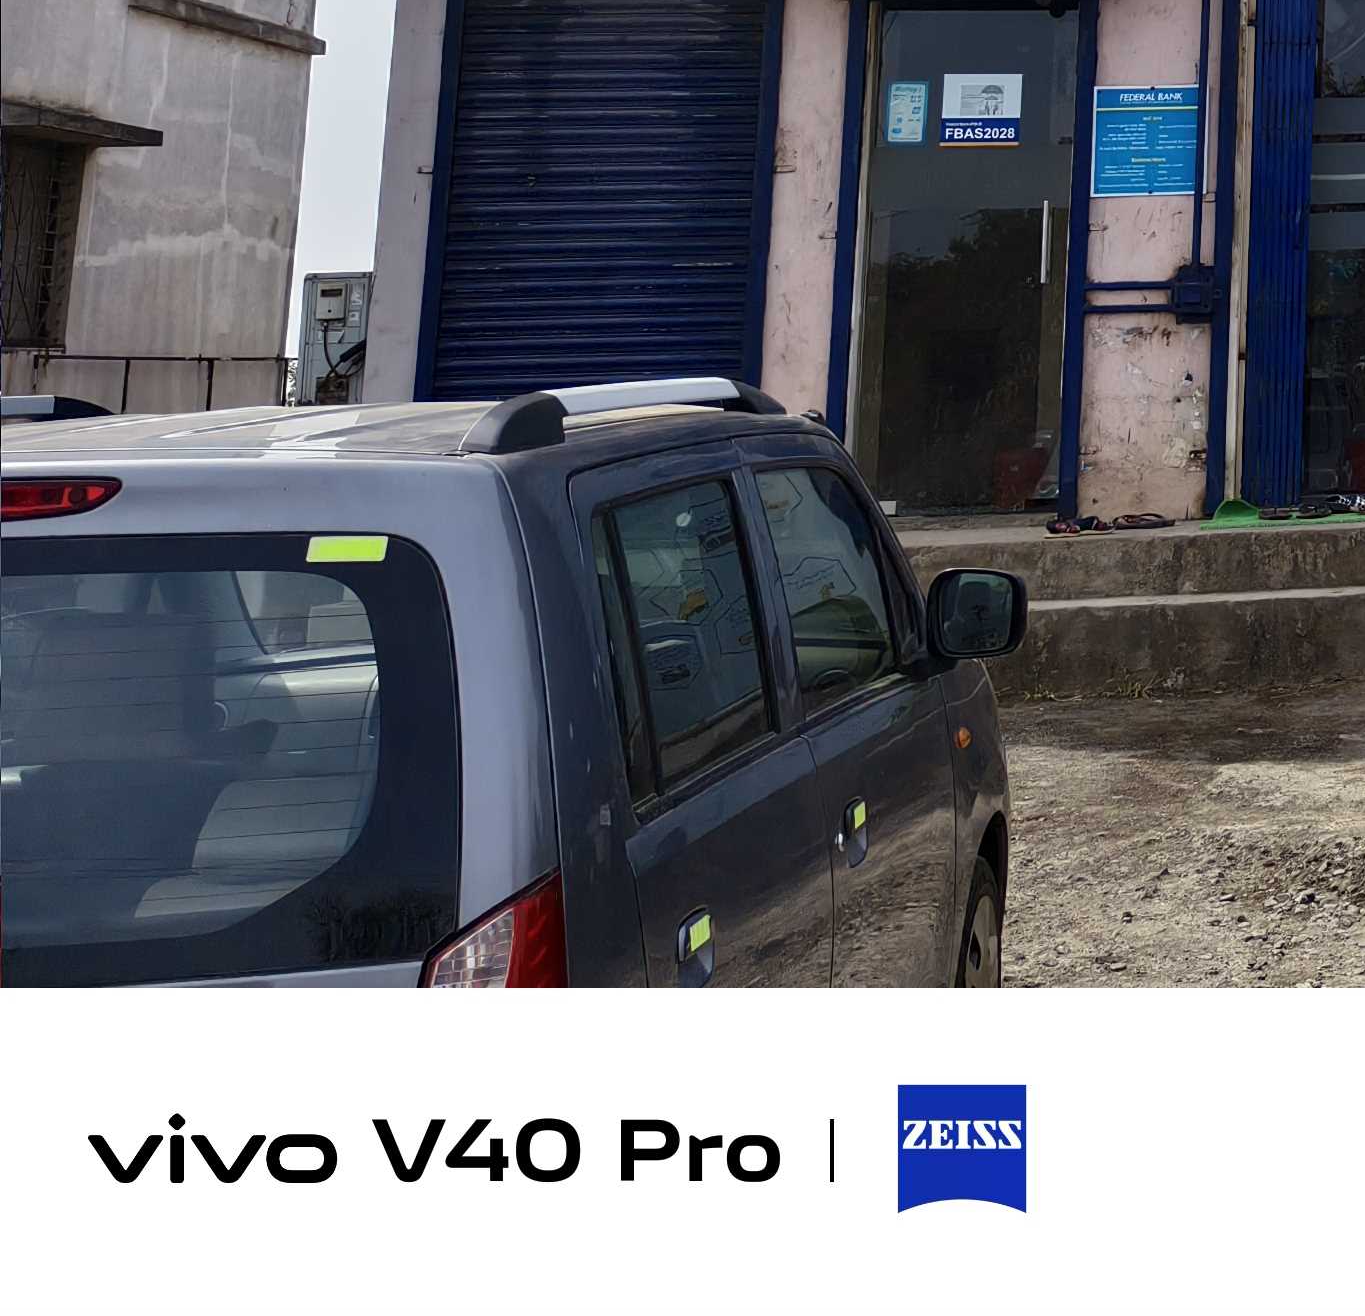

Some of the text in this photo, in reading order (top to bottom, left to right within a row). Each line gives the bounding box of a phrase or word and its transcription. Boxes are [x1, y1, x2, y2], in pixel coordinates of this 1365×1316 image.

[1120, 92, 1183, 102] FEDERAL BANK
[945, 127, 1015, 139] FBAS2028
